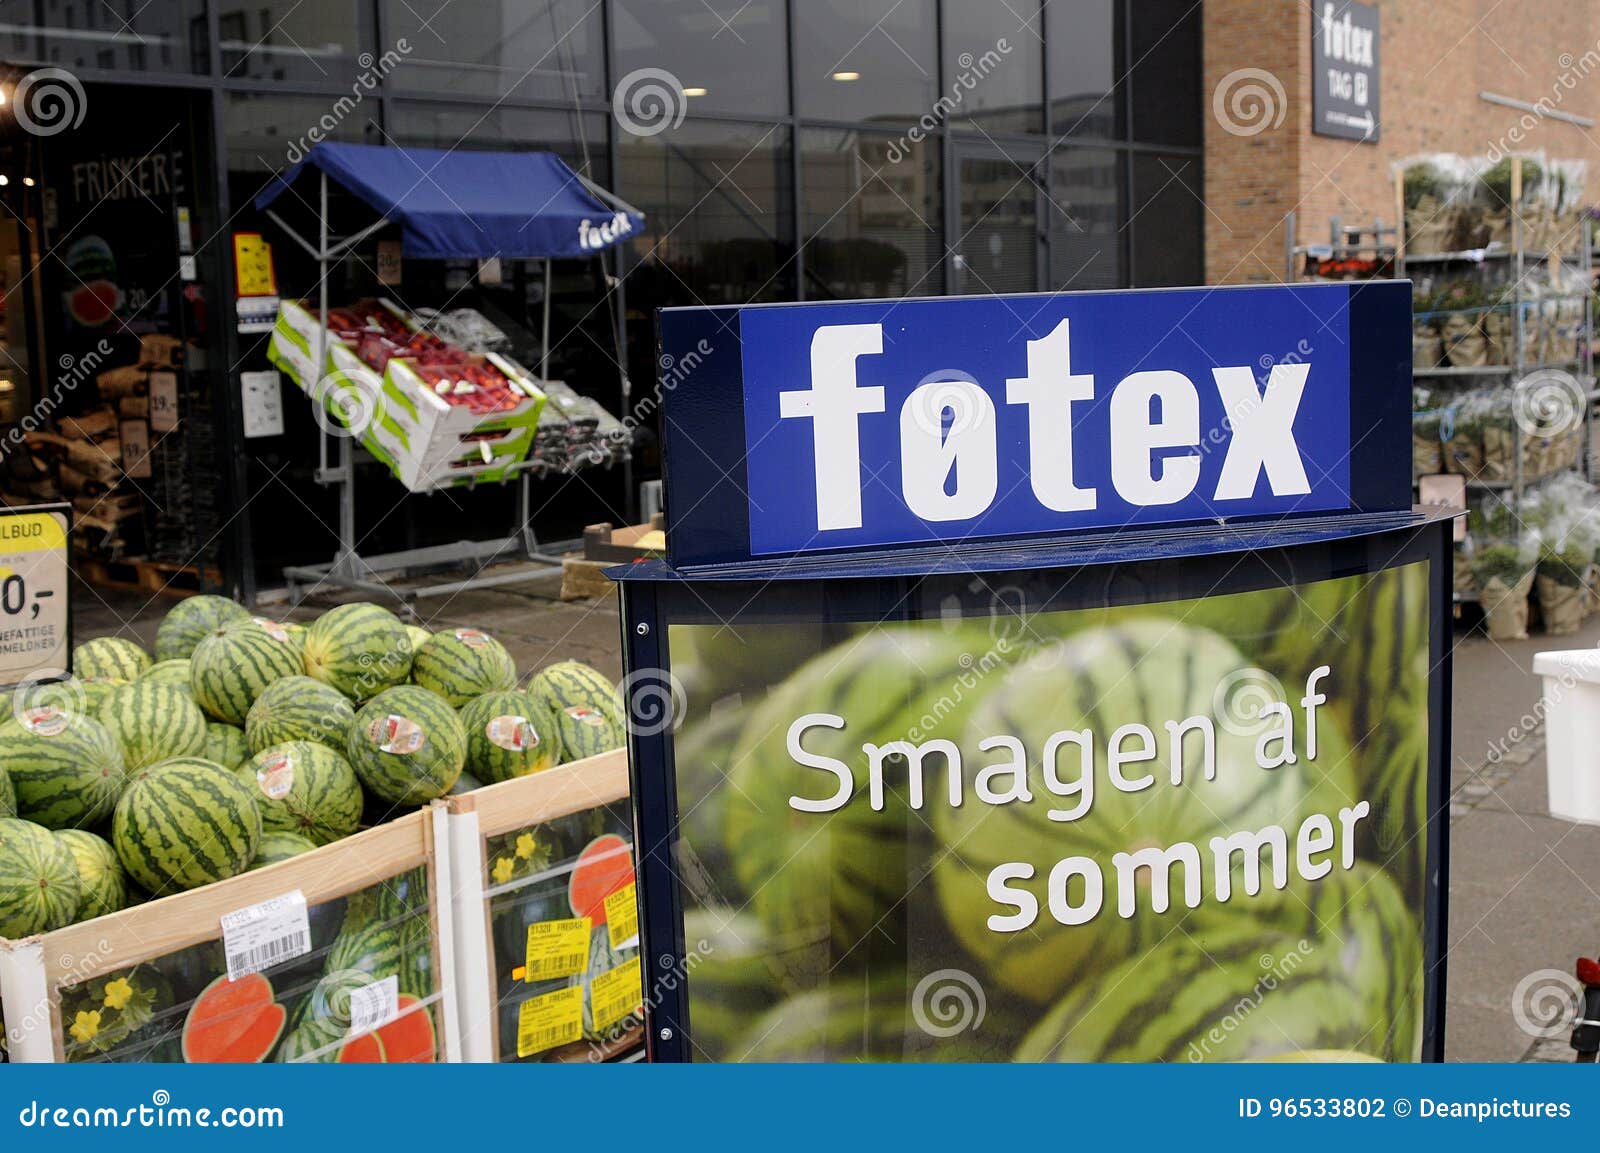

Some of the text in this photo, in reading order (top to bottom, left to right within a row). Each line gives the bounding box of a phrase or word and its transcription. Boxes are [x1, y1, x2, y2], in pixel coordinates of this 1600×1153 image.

[780, 318, 1312, 531] føtex
[0, 522, 42, 540] LBUD
[786, 665, 1331, 822] Smagen af
[986, 800, 1371, 933] sommer
